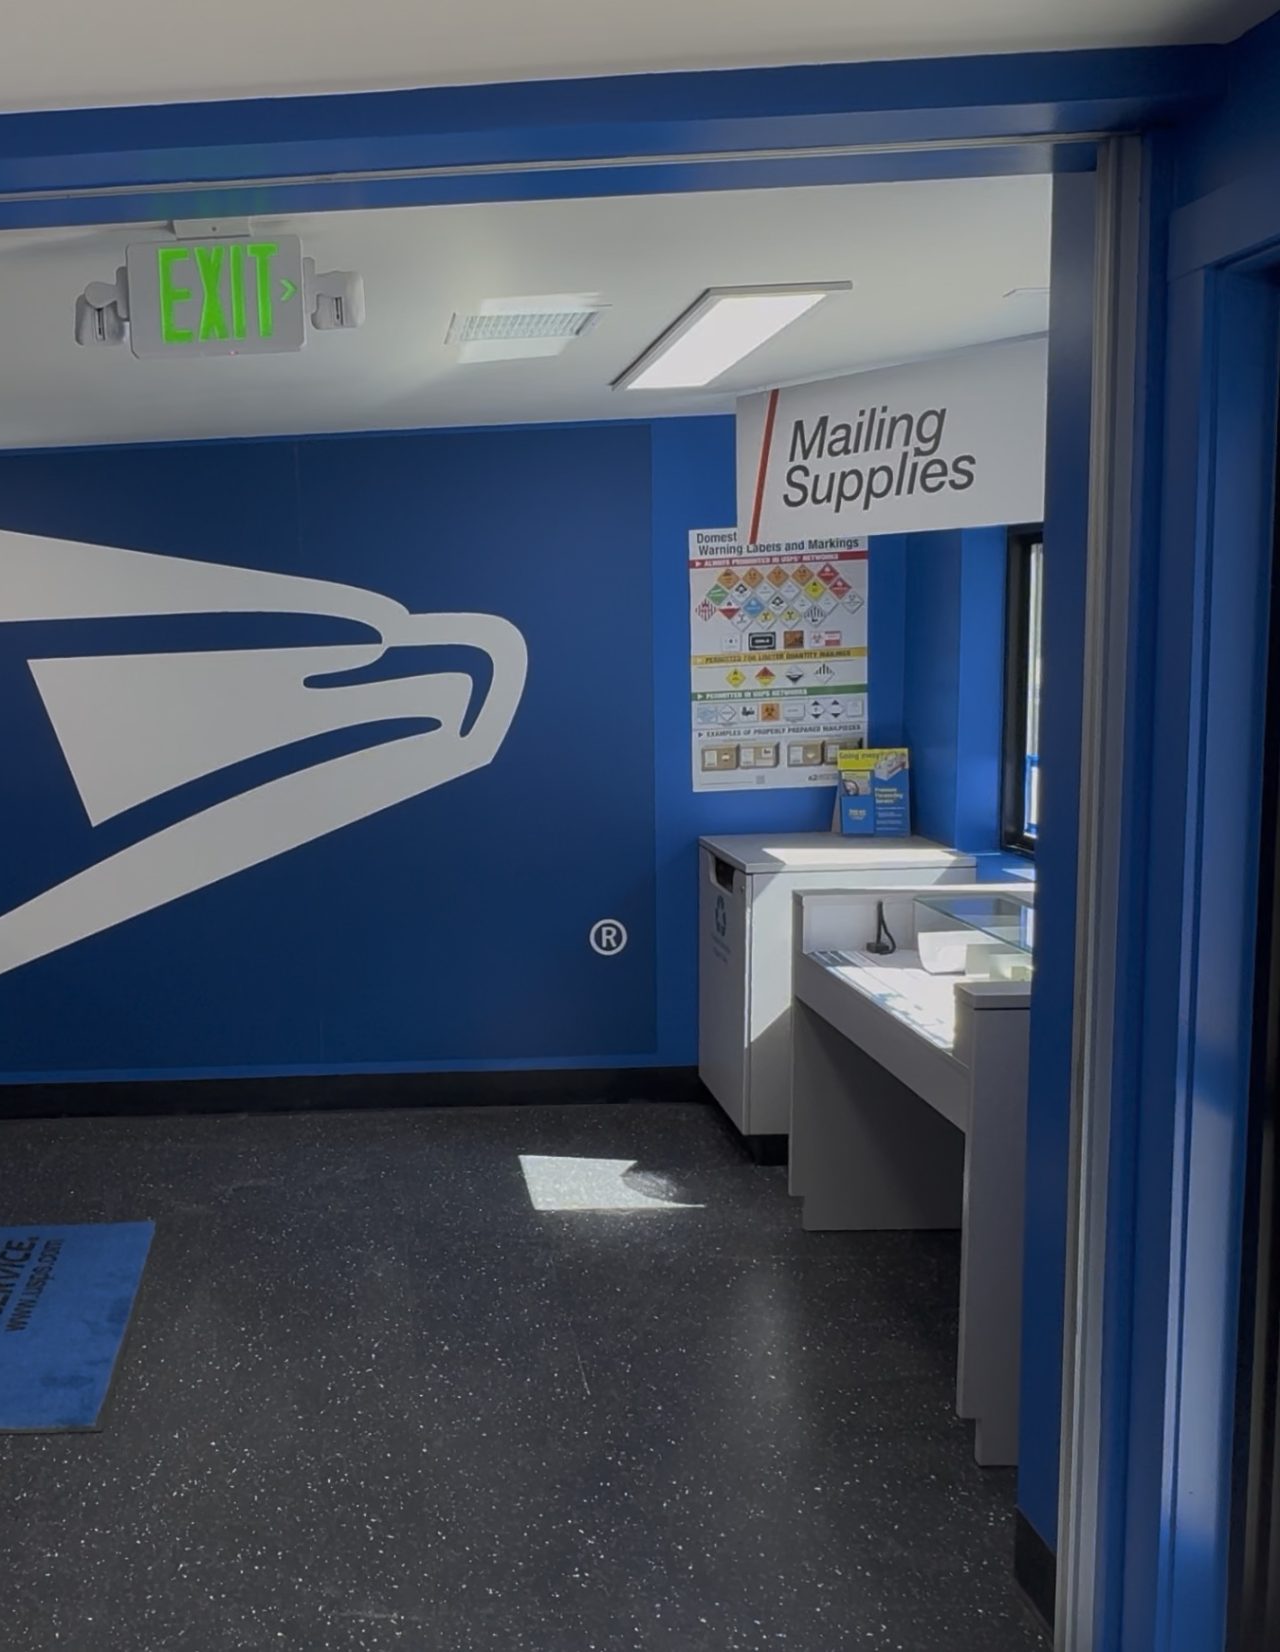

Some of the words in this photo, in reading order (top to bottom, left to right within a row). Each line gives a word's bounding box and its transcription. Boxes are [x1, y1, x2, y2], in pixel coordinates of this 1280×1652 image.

[158, 243, 278, 343] EXIT
[788, 405, 947, 462] Mailing
[783, 452, 977, 513] Supplies
[696, 532, 737, 544] Domest
[698, 544, 743, 556] Warning
[784, 540, 805, 551] and
[807, 537, 859, 550] Markings
[4, 1238, 65, 1332] www.usps.com
